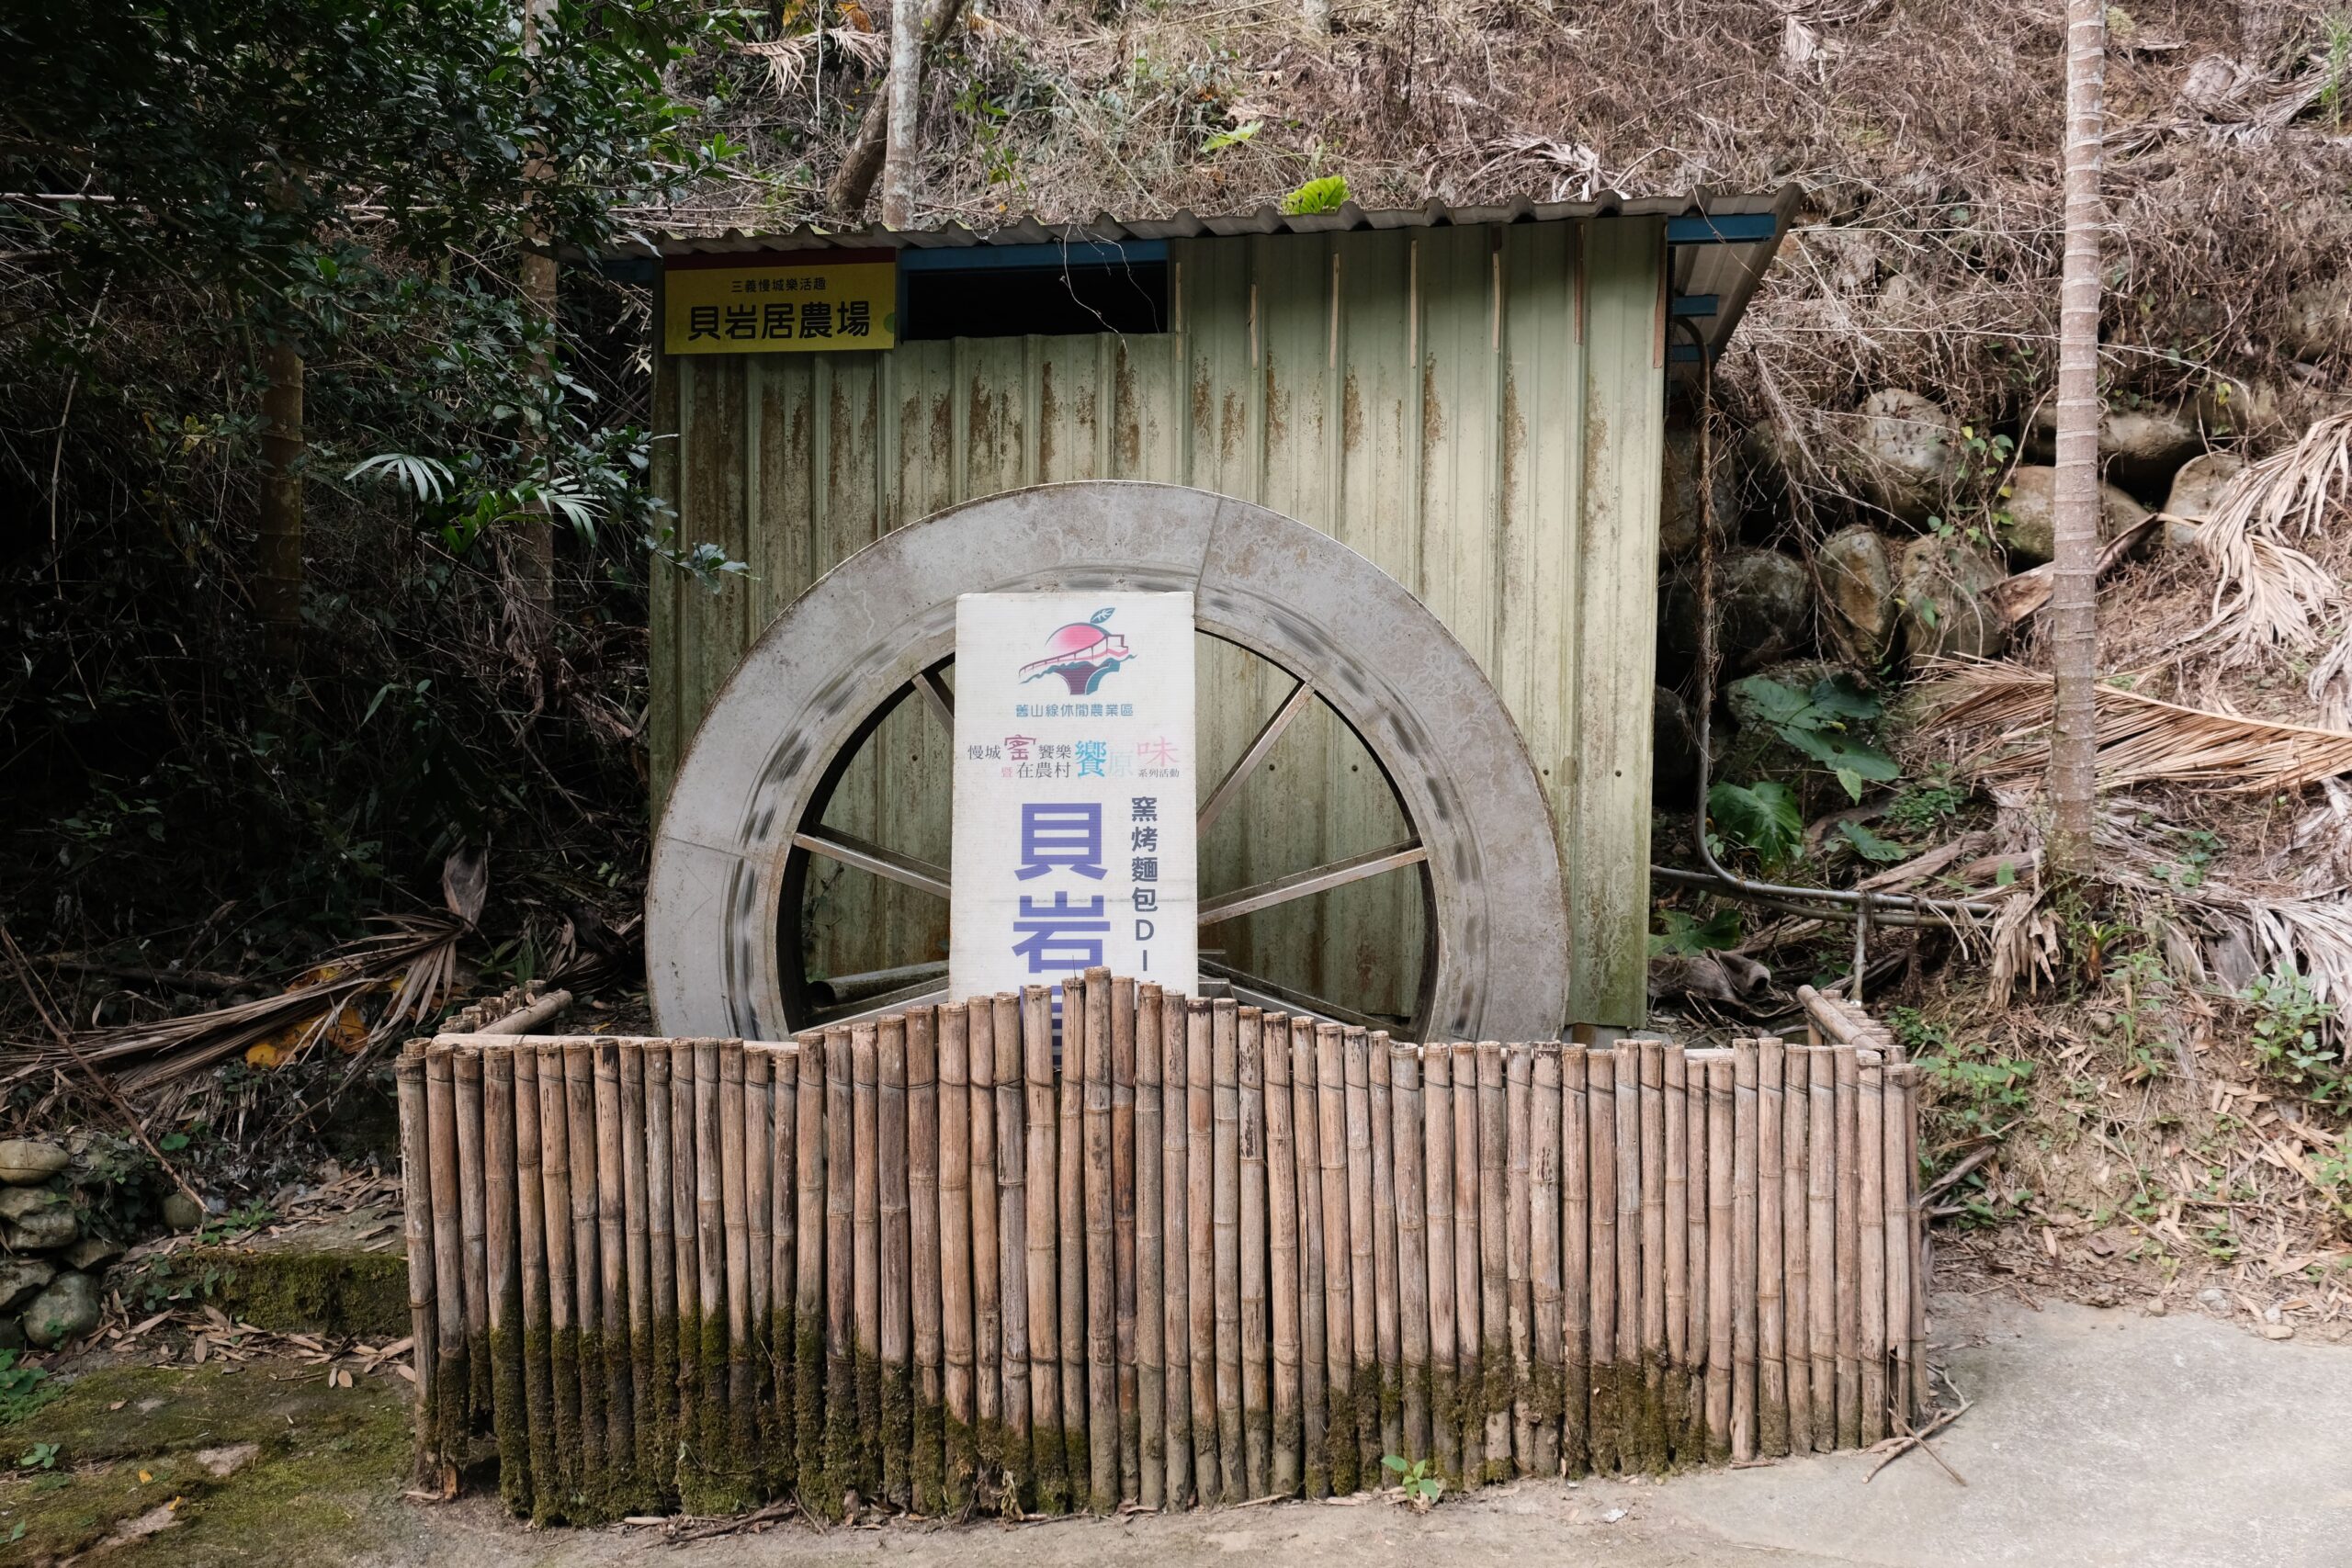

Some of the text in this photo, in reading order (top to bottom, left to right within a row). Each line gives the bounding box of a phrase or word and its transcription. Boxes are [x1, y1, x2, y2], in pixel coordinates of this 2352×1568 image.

[730, 276, 827, 293] 三義慢城樂活趣
[687, 301, 871, 341] 貝岩居農場
[1138, 768, 1180, 778] 系列活動
[1131, 796, 1159, 983] 窯烤麵包DI
